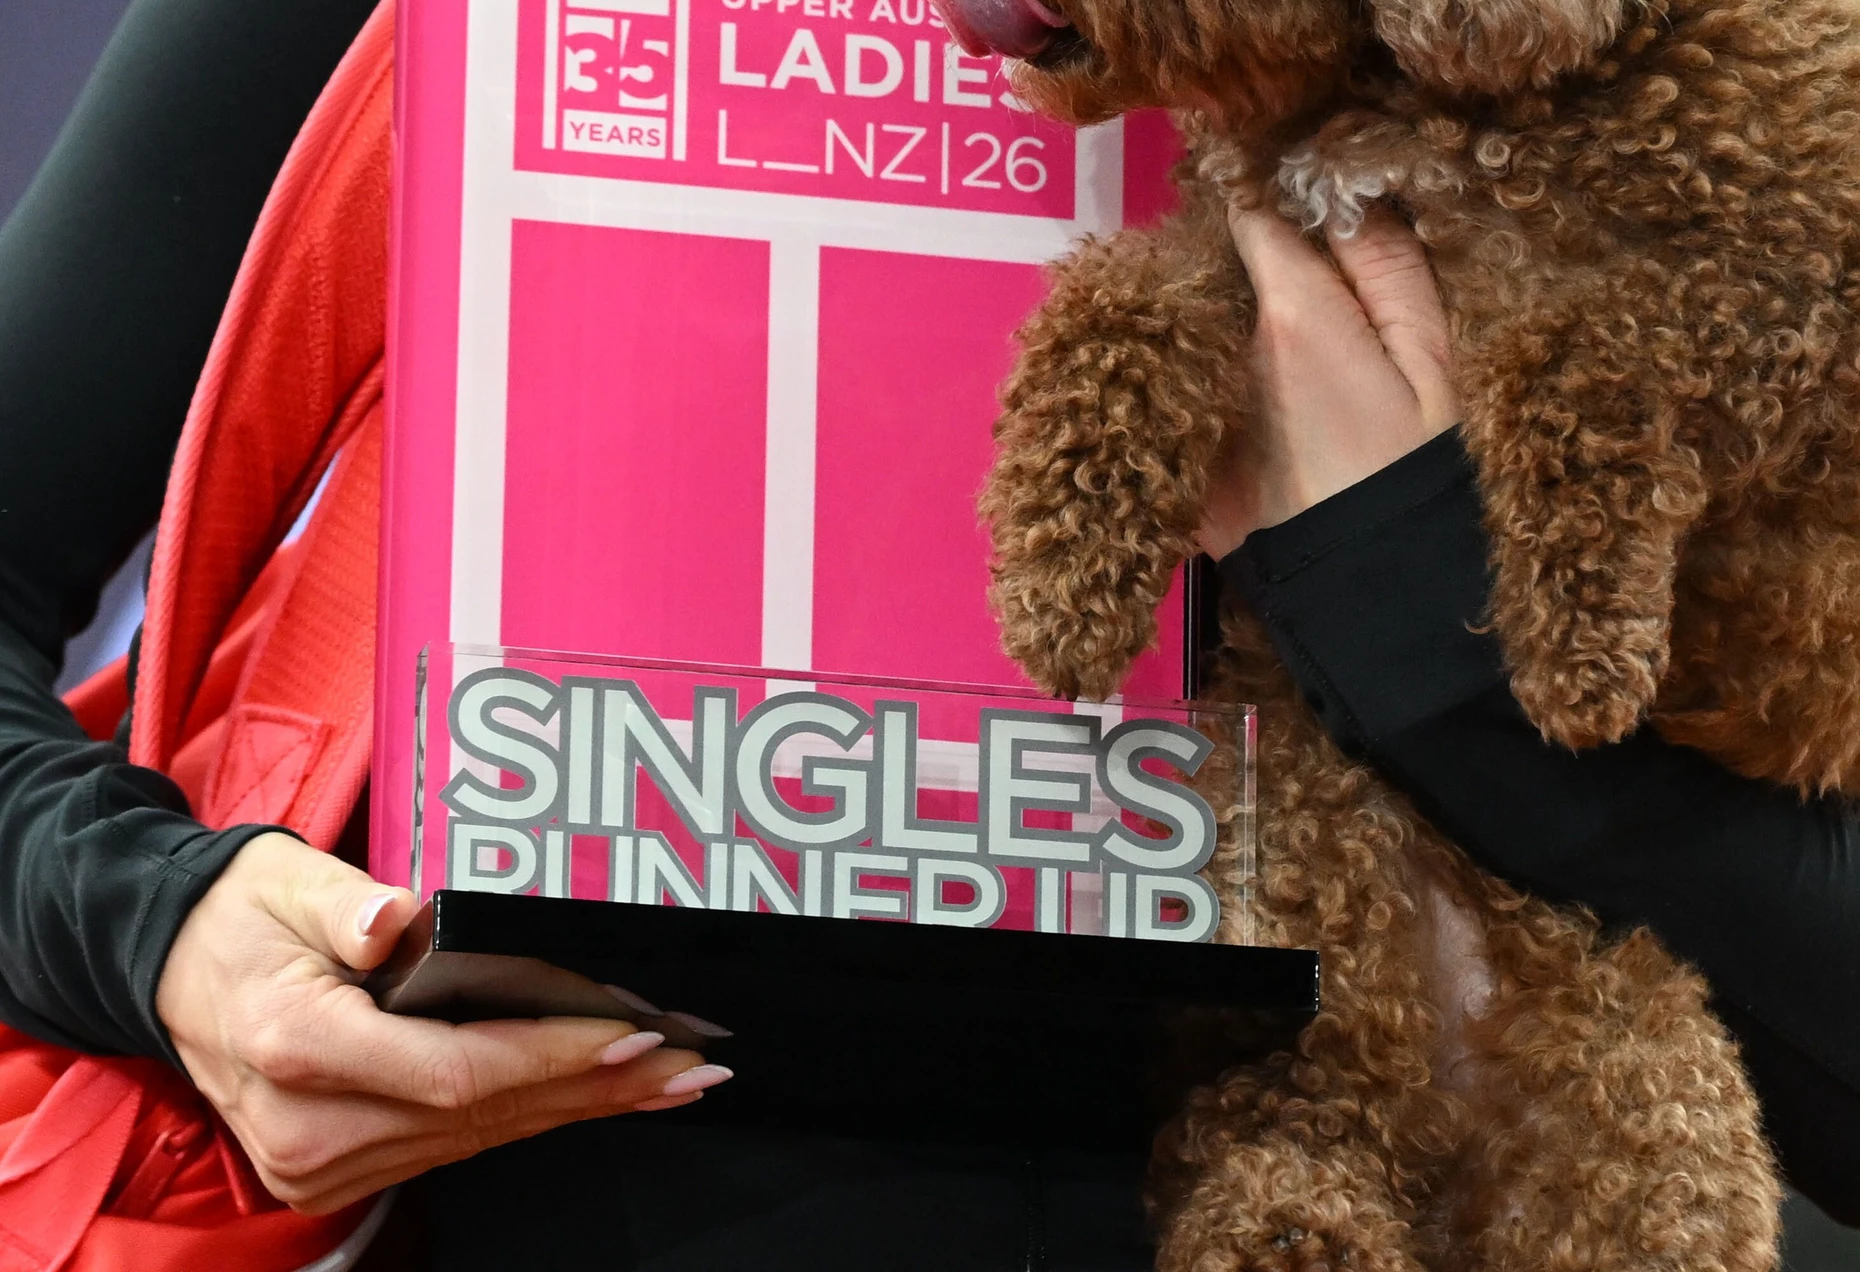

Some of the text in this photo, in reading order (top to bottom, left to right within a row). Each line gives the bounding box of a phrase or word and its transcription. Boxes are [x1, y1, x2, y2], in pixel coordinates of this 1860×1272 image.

[565, 13, 671, 110] 35
[571, 121, 661, 147] YEARS
[440, 668, 1215, 870] SINGLES
